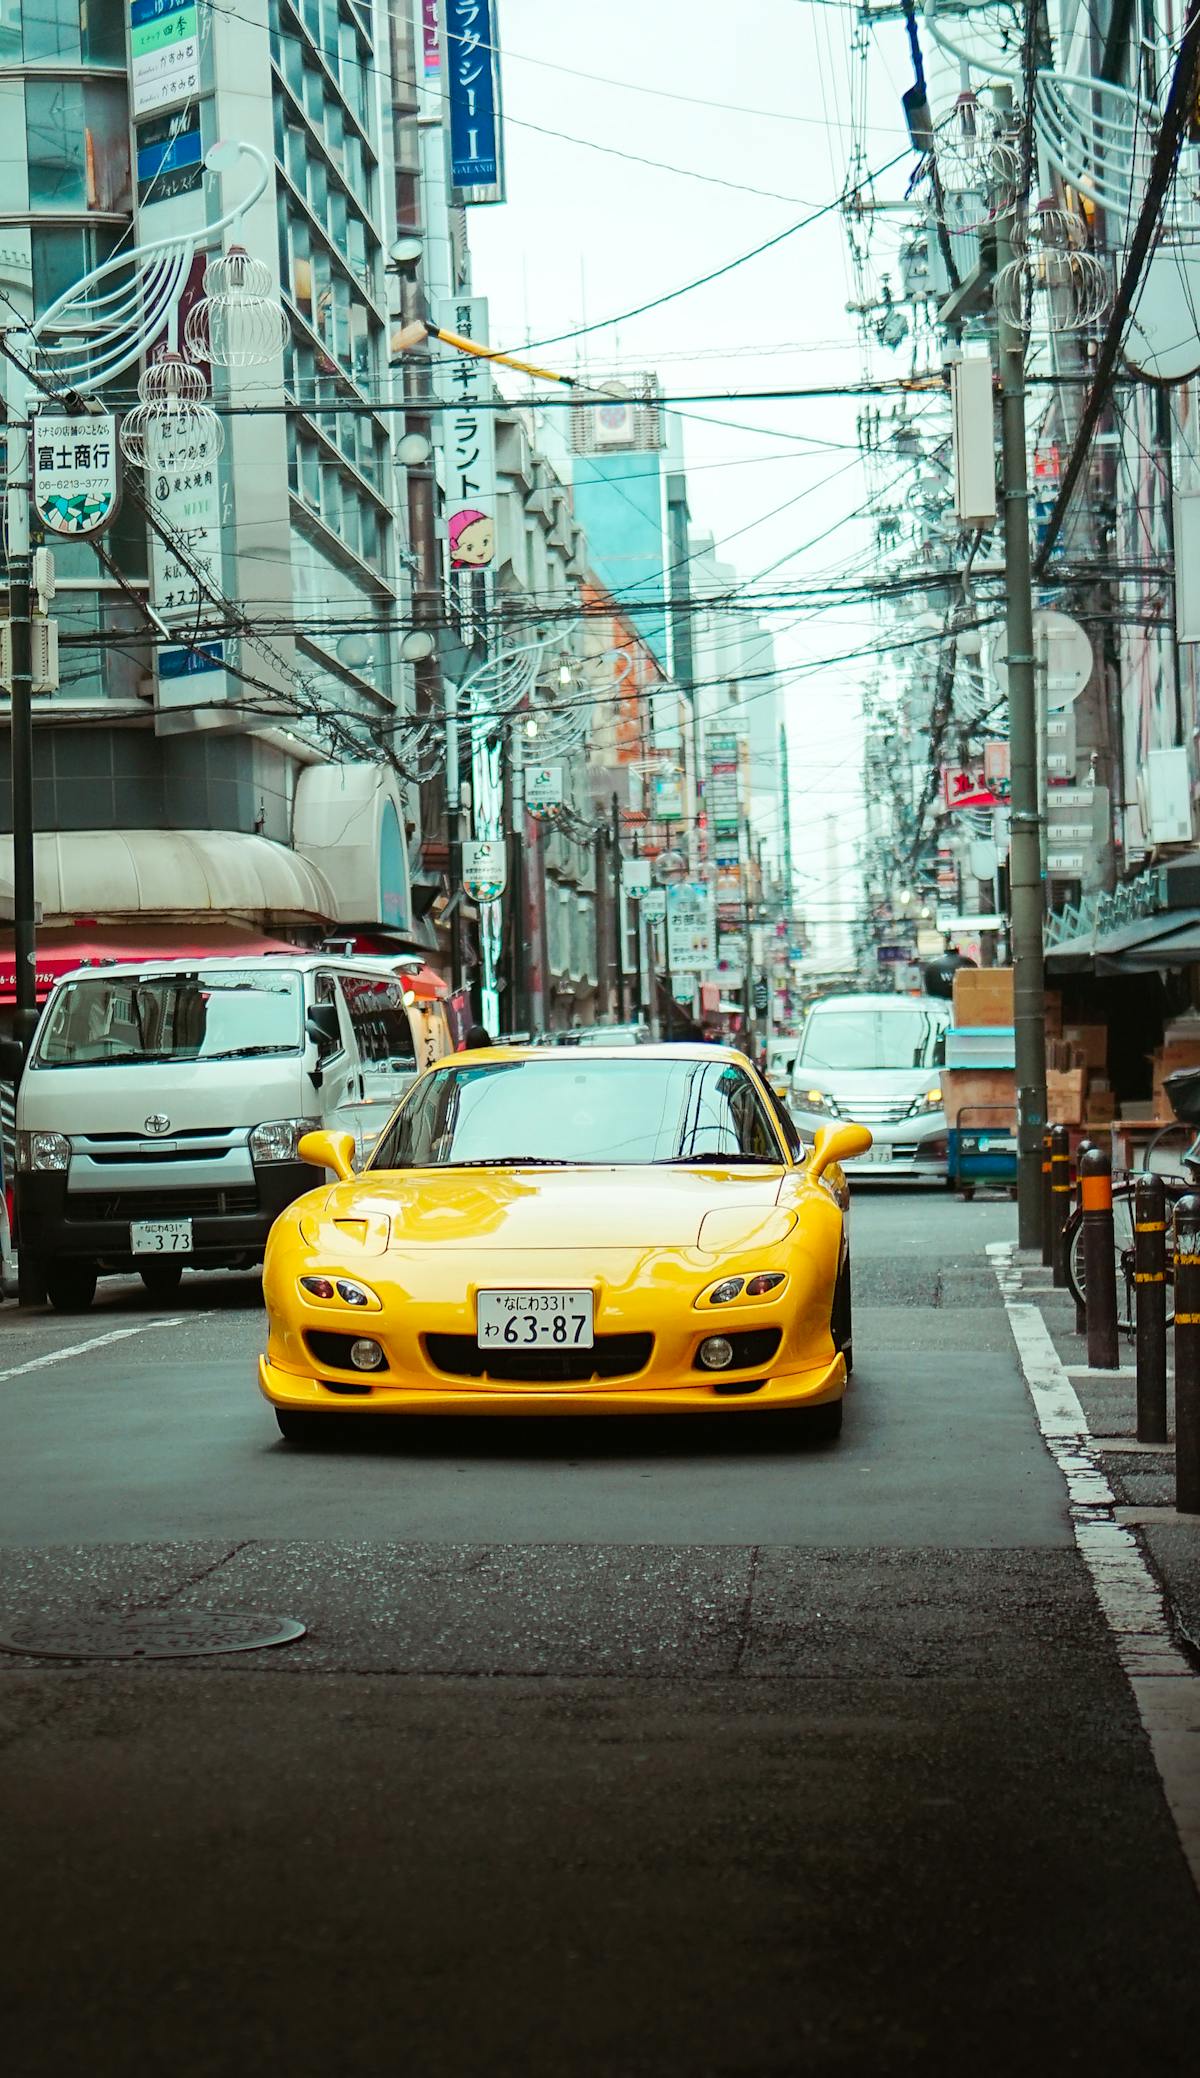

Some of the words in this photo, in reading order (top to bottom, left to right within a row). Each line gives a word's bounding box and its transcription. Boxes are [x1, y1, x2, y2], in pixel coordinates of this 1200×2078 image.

[38, 425, 110, 437] ミナミの店舗のことなら
[38, 444, 110, 471] 富士商行
[39, 478, 109, 490] 06-6213-3777
[504, 1296, 565, 1311] なにわ331
[484, 1322, 500, 1337] わ
[504, 1315, 586, 1343] 63-87
